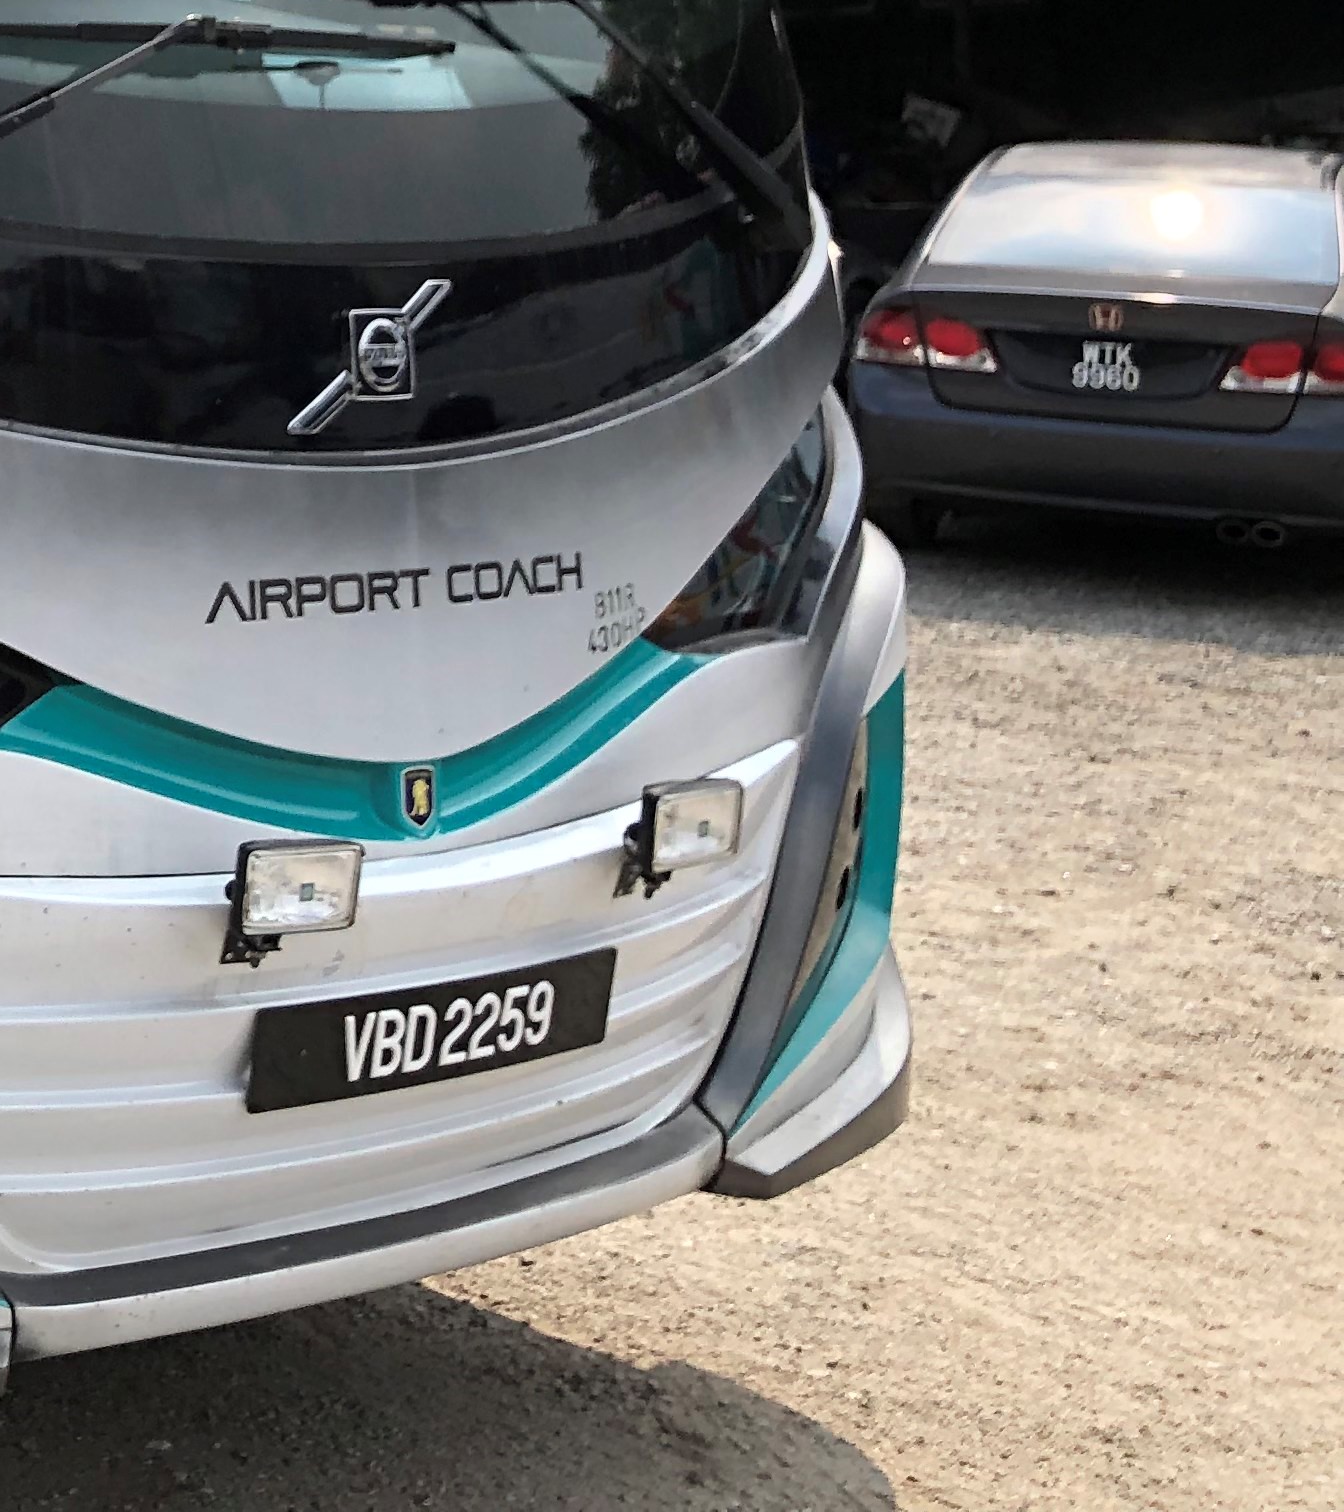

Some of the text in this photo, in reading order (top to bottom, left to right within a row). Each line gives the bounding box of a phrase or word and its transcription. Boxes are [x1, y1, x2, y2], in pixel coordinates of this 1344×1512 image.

[204, 551, 583, 625] AIRPORT COACH
[342, 978, 557, 1083] VBD 2259
